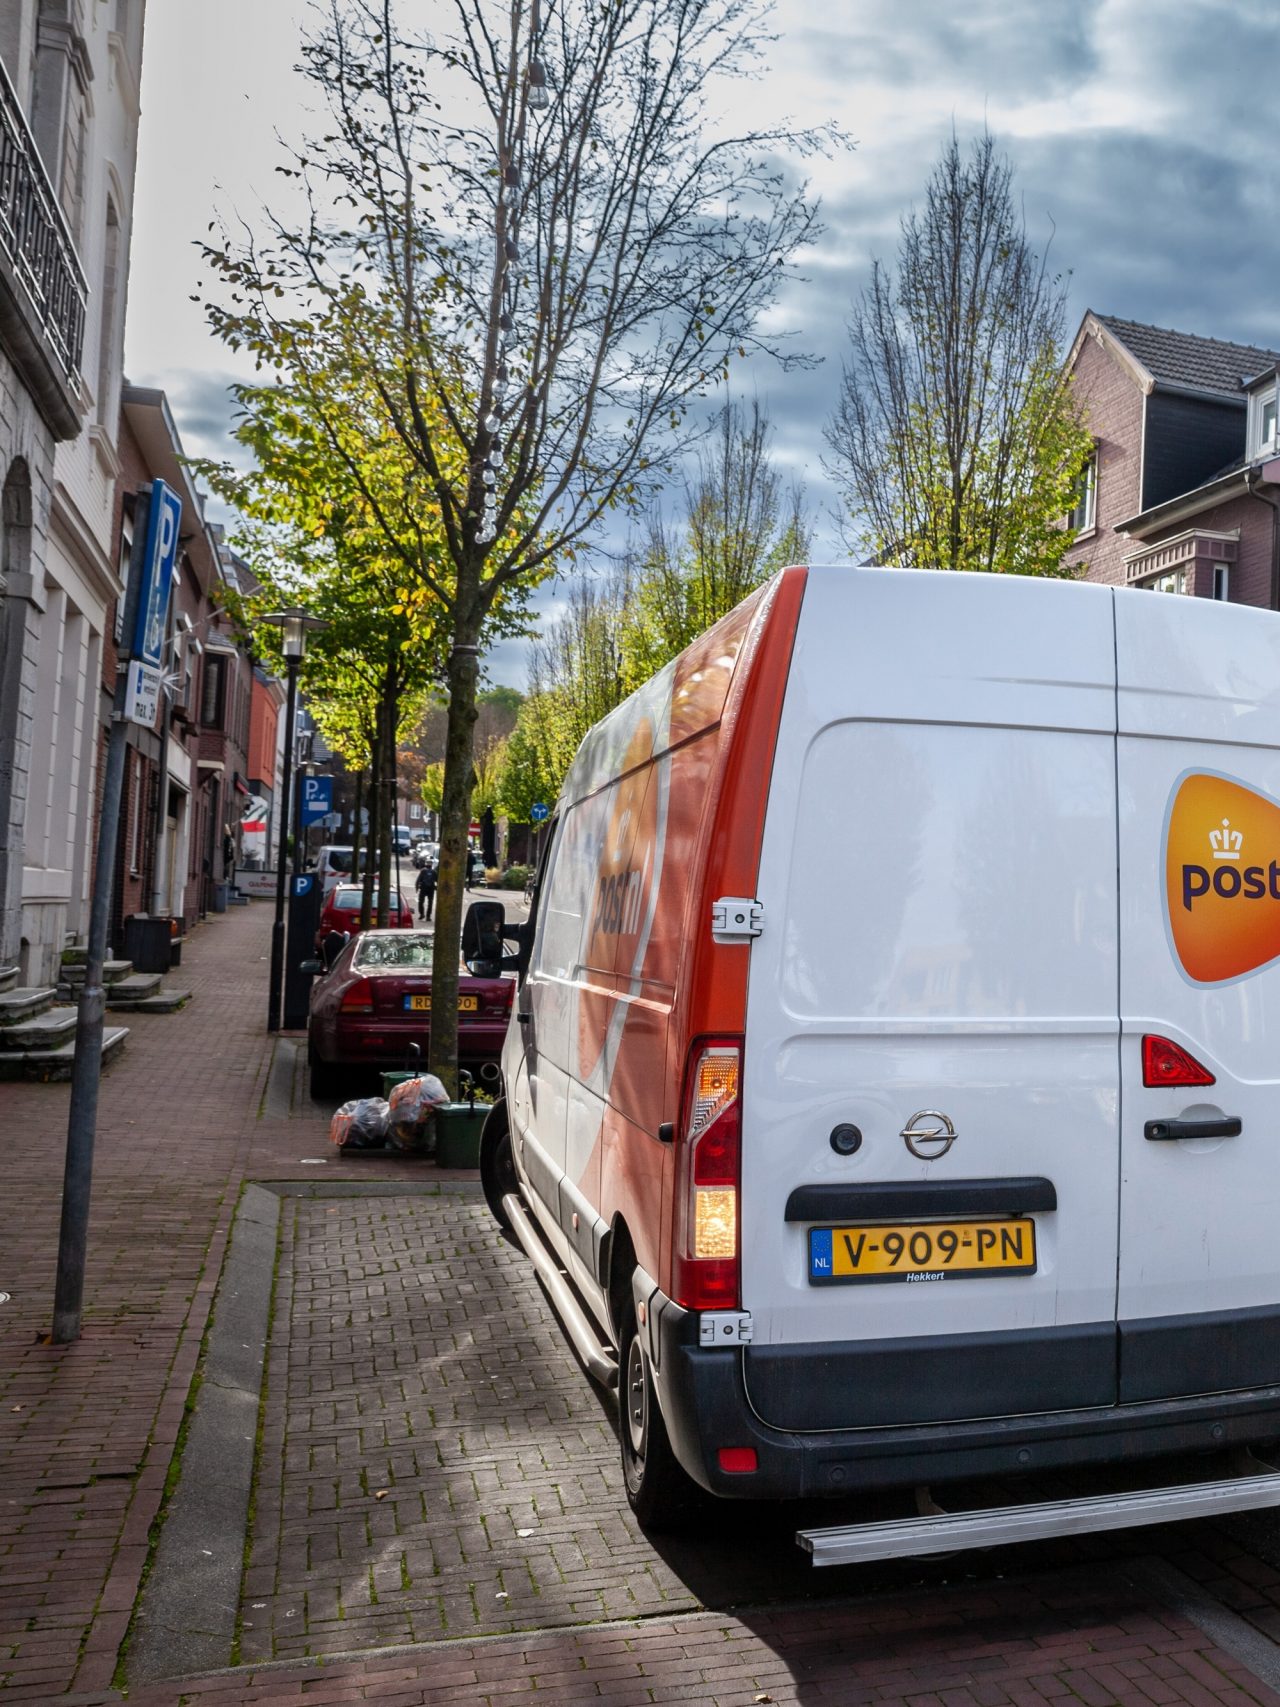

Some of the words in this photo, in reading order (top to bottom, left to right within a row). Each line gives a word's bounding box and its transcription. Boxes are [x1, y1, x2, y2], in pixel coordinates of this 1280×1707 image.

[155, 501, 174, 588] P
[305, 780, 319, 800] P
[296, 877, 308, 893] P
[843, 1227, 1023, 1268] V-909-PN
[814, 1257, 830, 1268] NL
[906, 1271, 945, 1283] Hekkert
